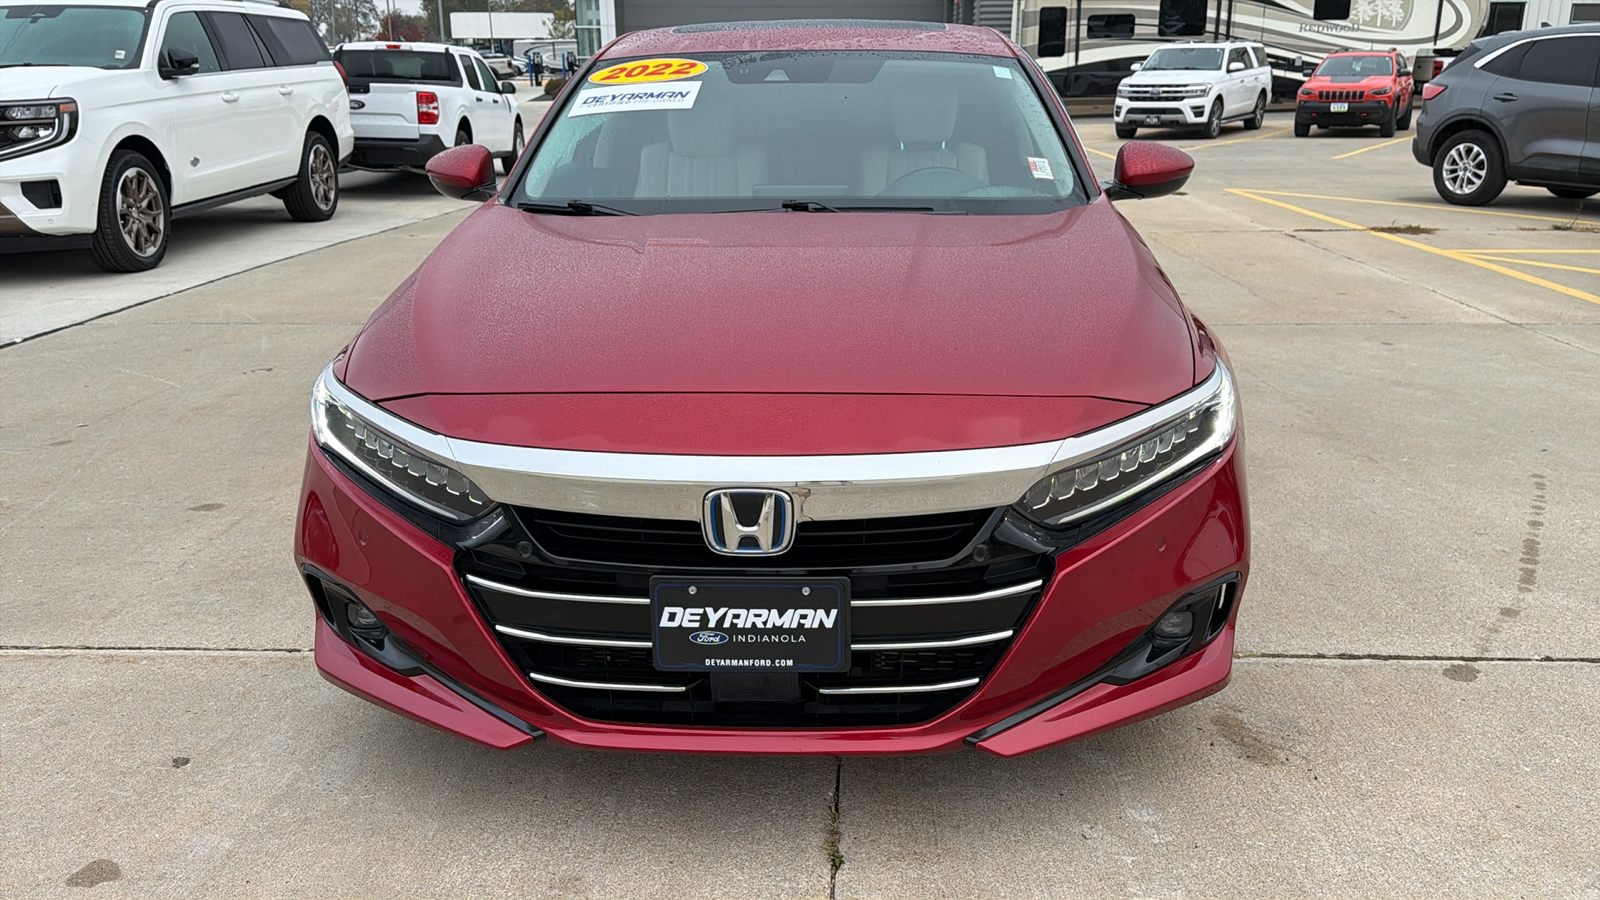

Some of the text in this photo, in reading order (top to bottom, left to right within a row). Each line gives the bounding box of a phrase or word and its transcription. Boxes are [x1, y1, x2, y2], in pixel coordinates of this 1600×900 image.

[1299, 23, 1360, 33] REDWOOD
[599, 63, 698, 80] 2022
[581, 91, 691, 105] DEYARMAN
[587, 100, 631, 108] CERTIFIED
[659, 606, 838, 629] DEYARMAN
[733, 634, 807, 643] INDIANOLA
[705, 658, 794, 667] DEYARMANFORD.COM
